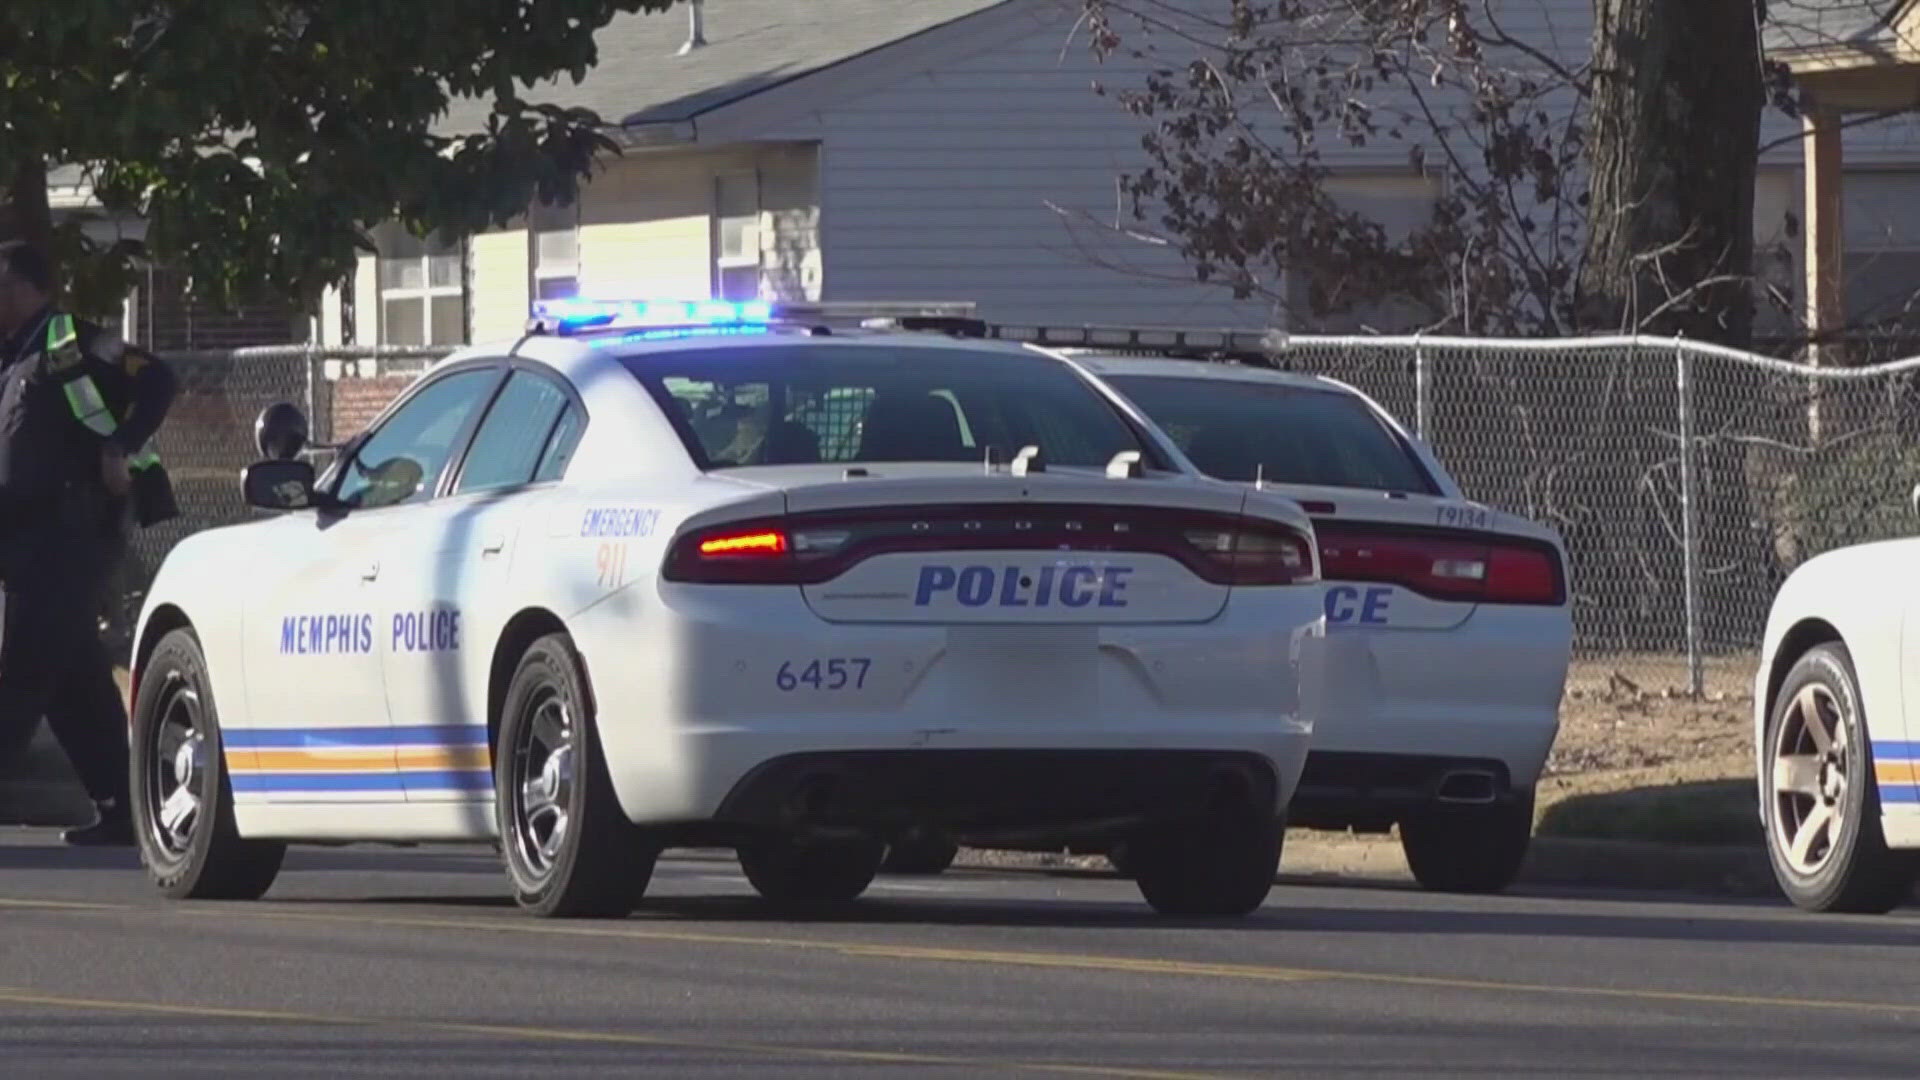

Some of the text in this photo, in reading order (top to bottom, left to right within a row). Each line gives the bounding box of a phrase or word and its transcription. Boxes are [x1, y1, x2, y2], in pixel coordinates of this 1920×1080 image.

[580, 507, 662, 537] EMERGENCY
[597, 543, 627, 588] 911
[914, 565, 1134, 608] POLICE
[280, 610, 461, 655] MEMPHIS POLICE
[775, 657, 872, 692] 6457
